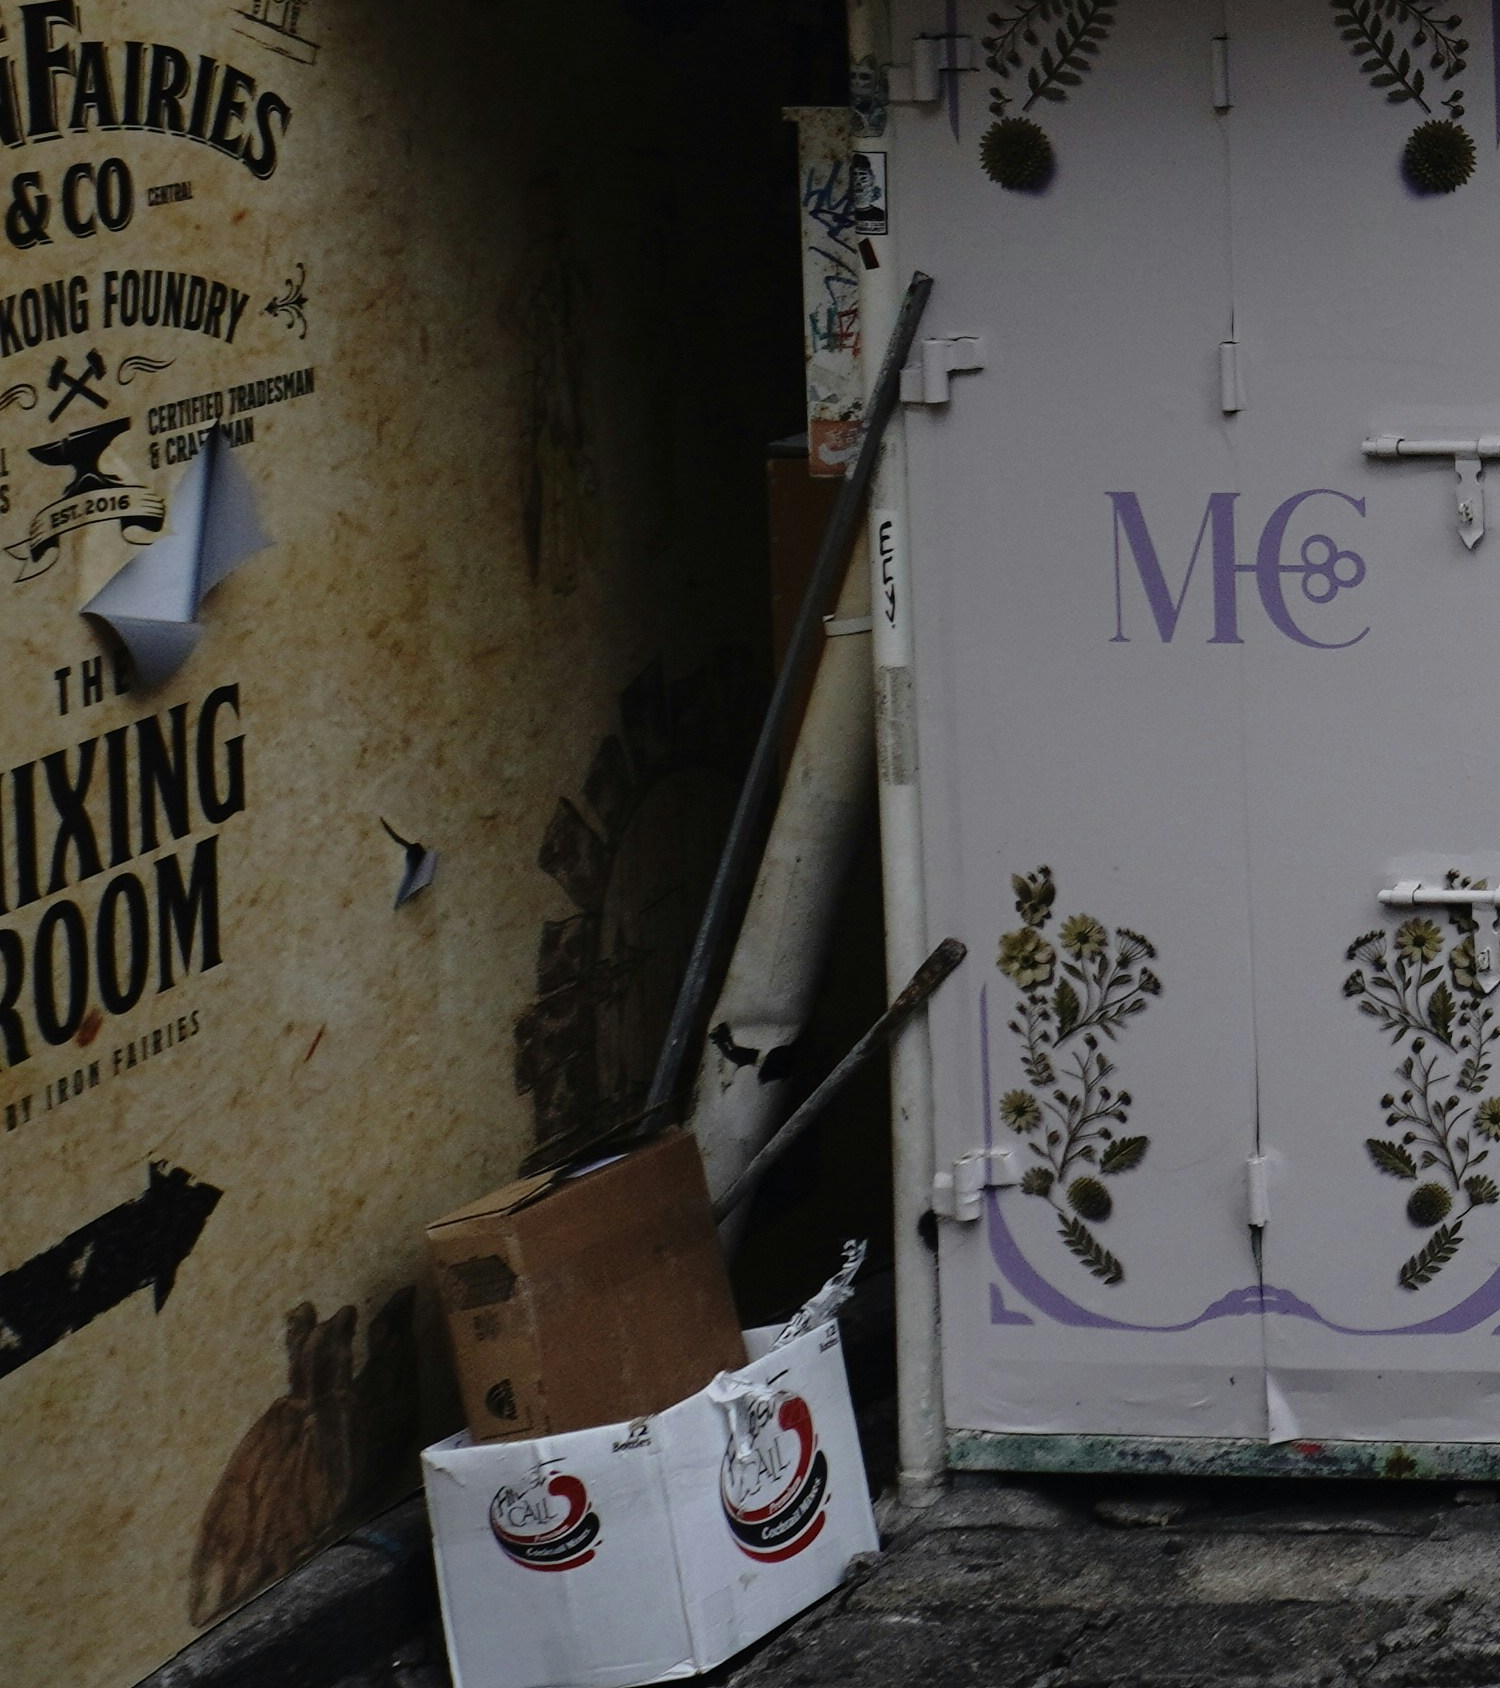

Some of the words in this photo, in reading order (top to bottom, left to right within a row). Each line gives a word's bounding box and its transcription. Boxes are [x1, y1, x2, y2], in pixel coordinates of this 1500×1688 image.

[5, 170, 53, 249] &
[62, 157, 136, 238] CO
[147, 180, 195, 207] CENTRAL
[103, 269, 250, 345] FOUNDRY
[147, 389, 225, 437] CERTIFIED
[228, 367, 316, 414] TRADESMAN
[165, 415, 256, 466] CRAFMAN
[84, 494, 131, 512] 2016
[54, 646, 131, 716] THE
[0, 683, 246, 910] IXING
[7, 1092, 32, 1133] BY
[46, 1065, 100, 1112] IRON
[112, 1010, 202, 1077] FAIRIES
[508, 1496, 559, 1528] CALL
